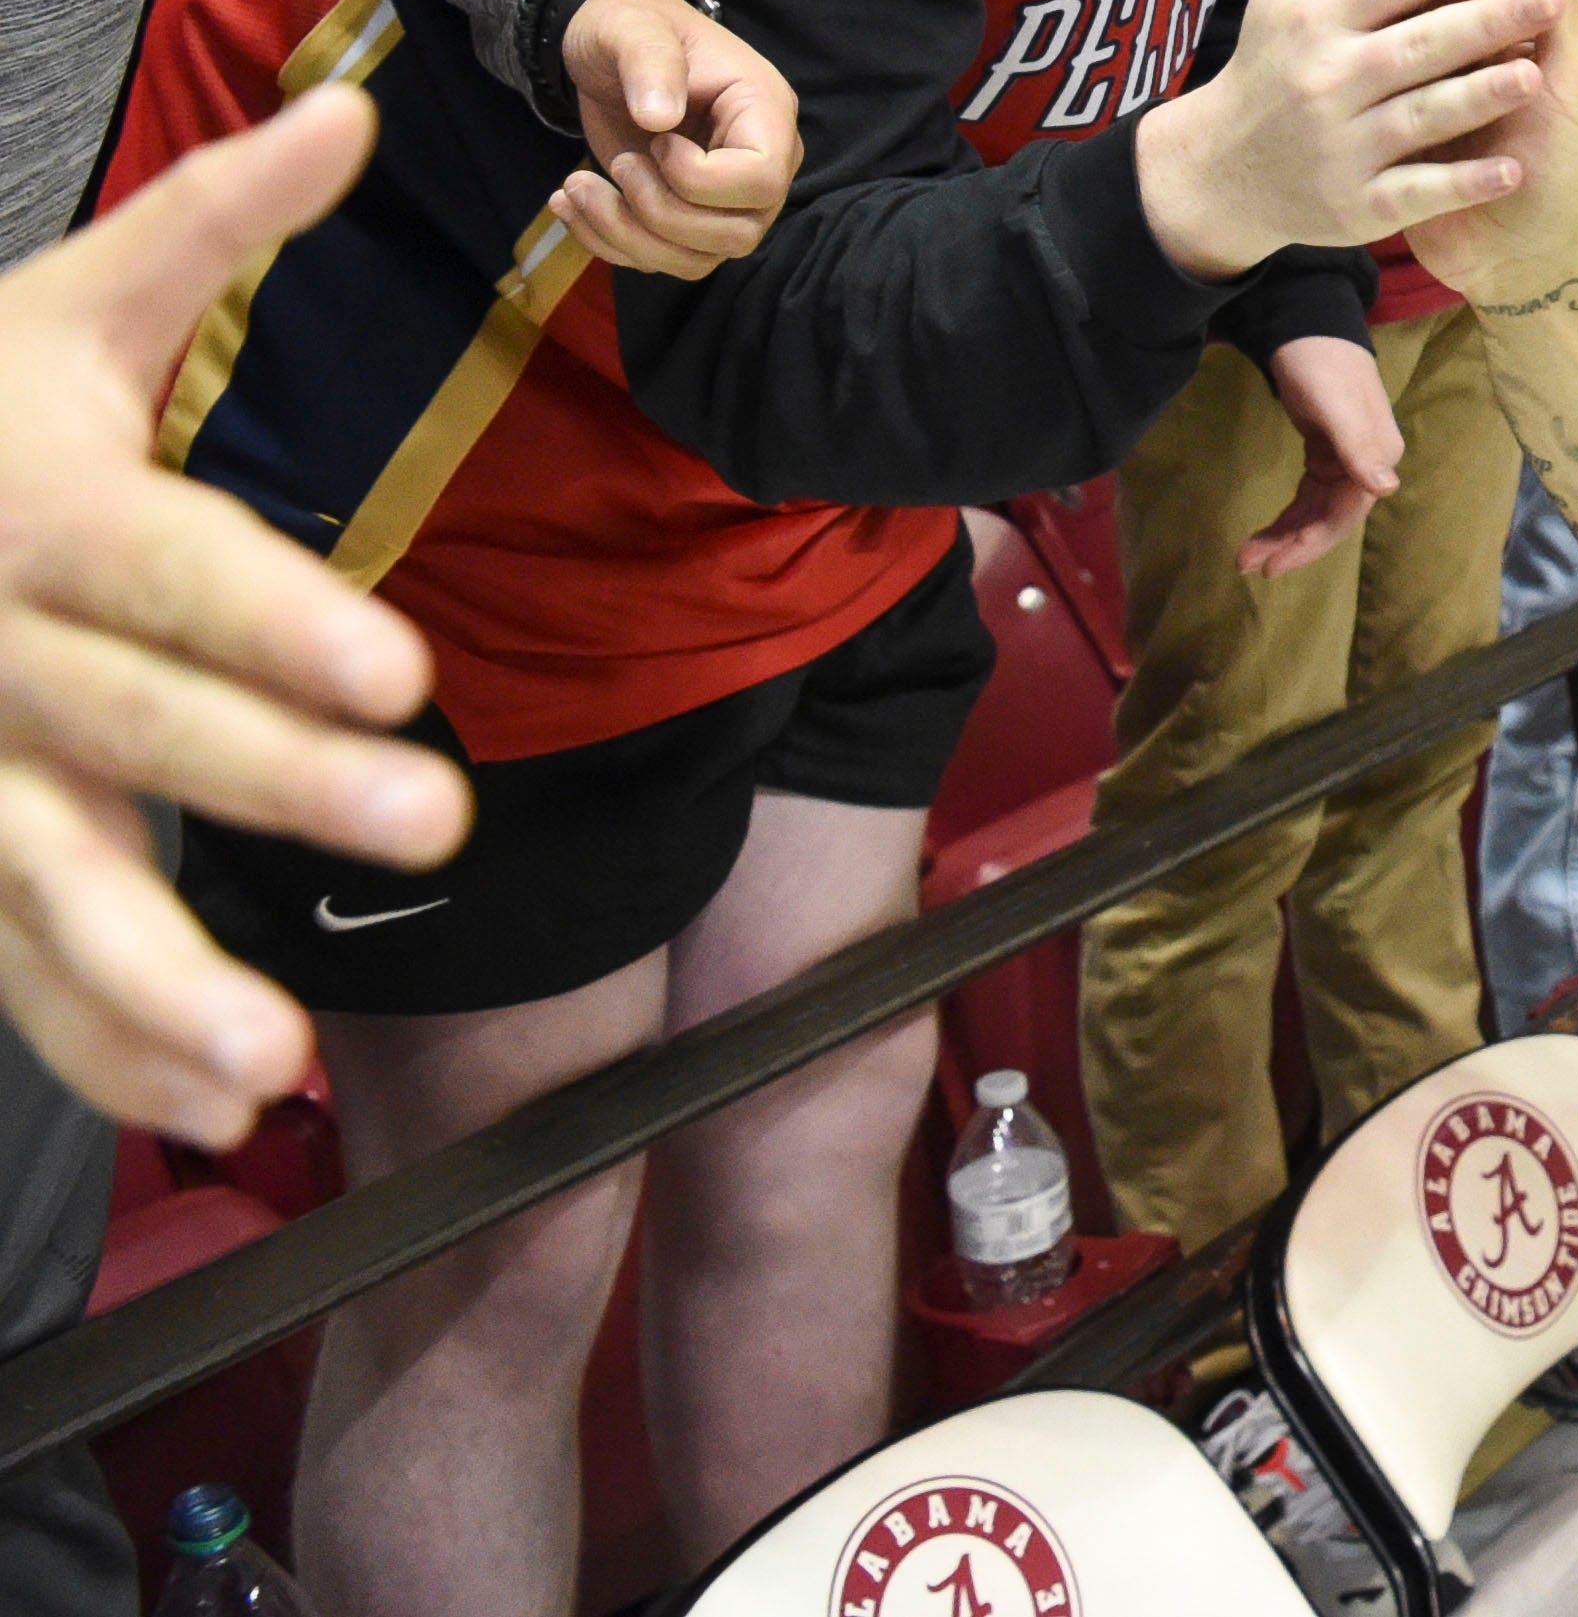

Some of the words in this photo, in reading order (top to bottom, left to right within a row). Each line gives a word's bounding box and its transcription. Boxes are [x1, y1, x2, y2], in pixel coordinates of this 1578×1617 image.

[1424, 1104, 1553, 1233] ALABAMA
[1480, 1150, 1545, 1270] A
[1456, 1263, 1567, 1326] CRIMSON
[844, 1493, 1034, 1617] LABAMA
